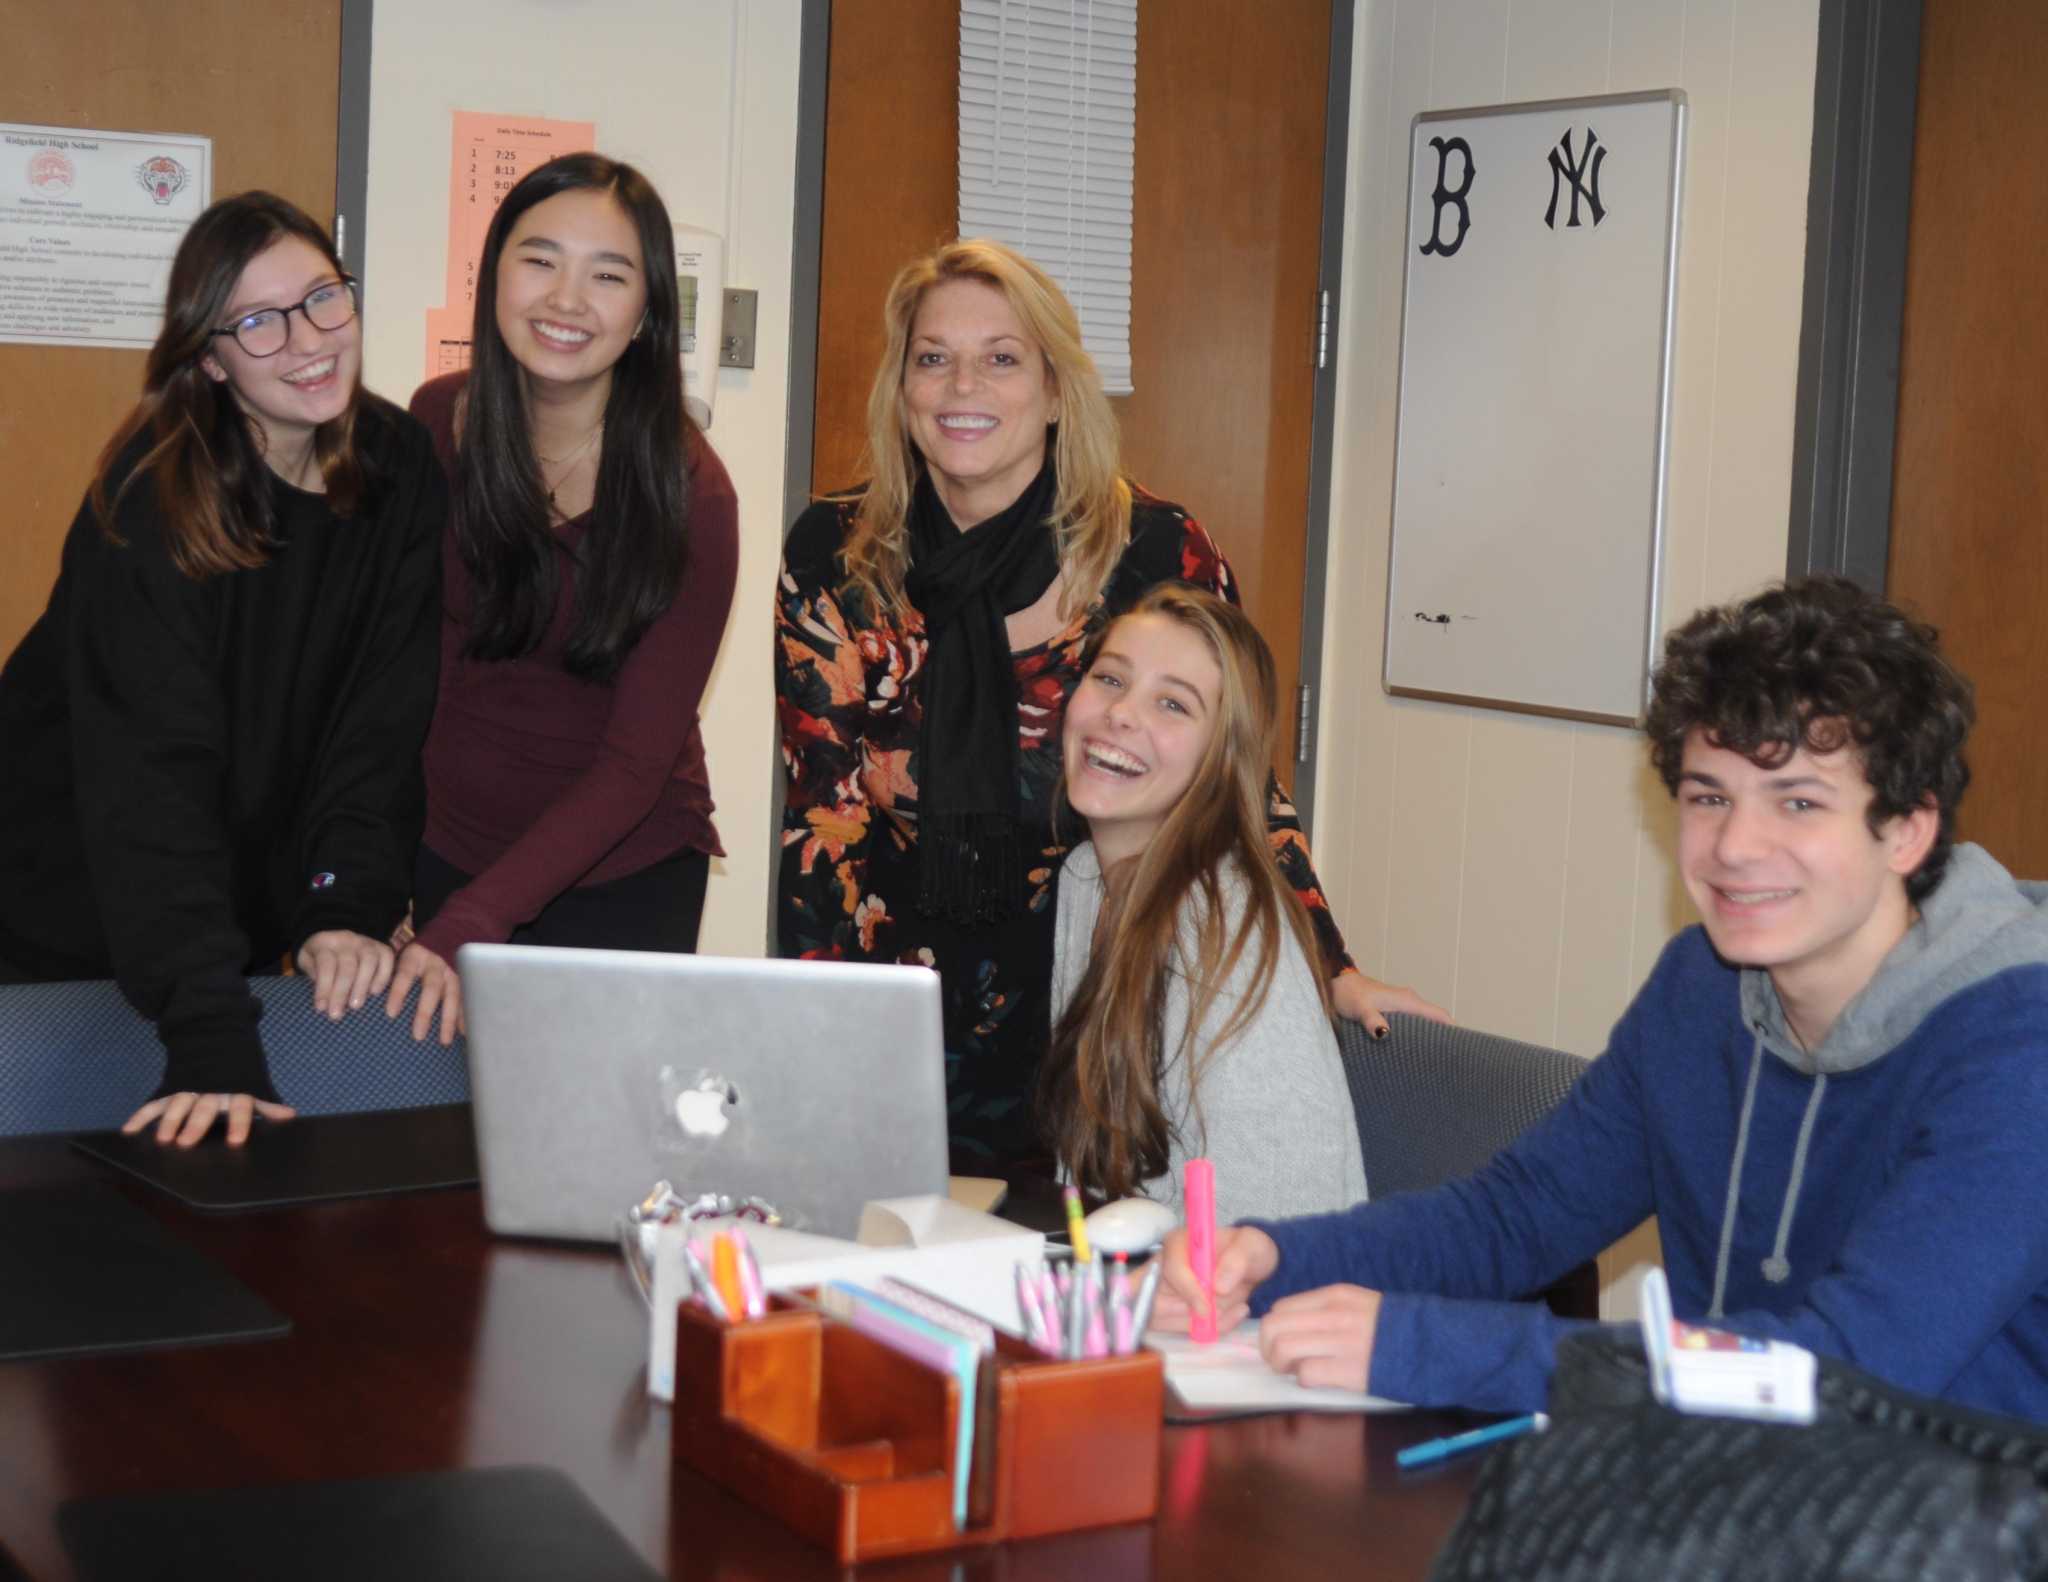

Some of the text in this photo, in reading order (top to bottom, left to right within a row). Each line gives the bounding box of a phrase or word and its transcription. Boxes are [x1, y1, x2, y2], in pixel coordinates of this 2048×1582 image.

[48, 138, 69, 149] High
[71, 141, 98, 151] School
[471, 148, 516, 161] 1 7:25
[471, 163, 515, 176] 2 8:13
[470, 179, 476, 188] 3
[470, 194, 475, 204] 4
[1419, 135, 1477, 258] B
[467, 262, 473, 271] 5
[467, 277, 473, 286] 6
